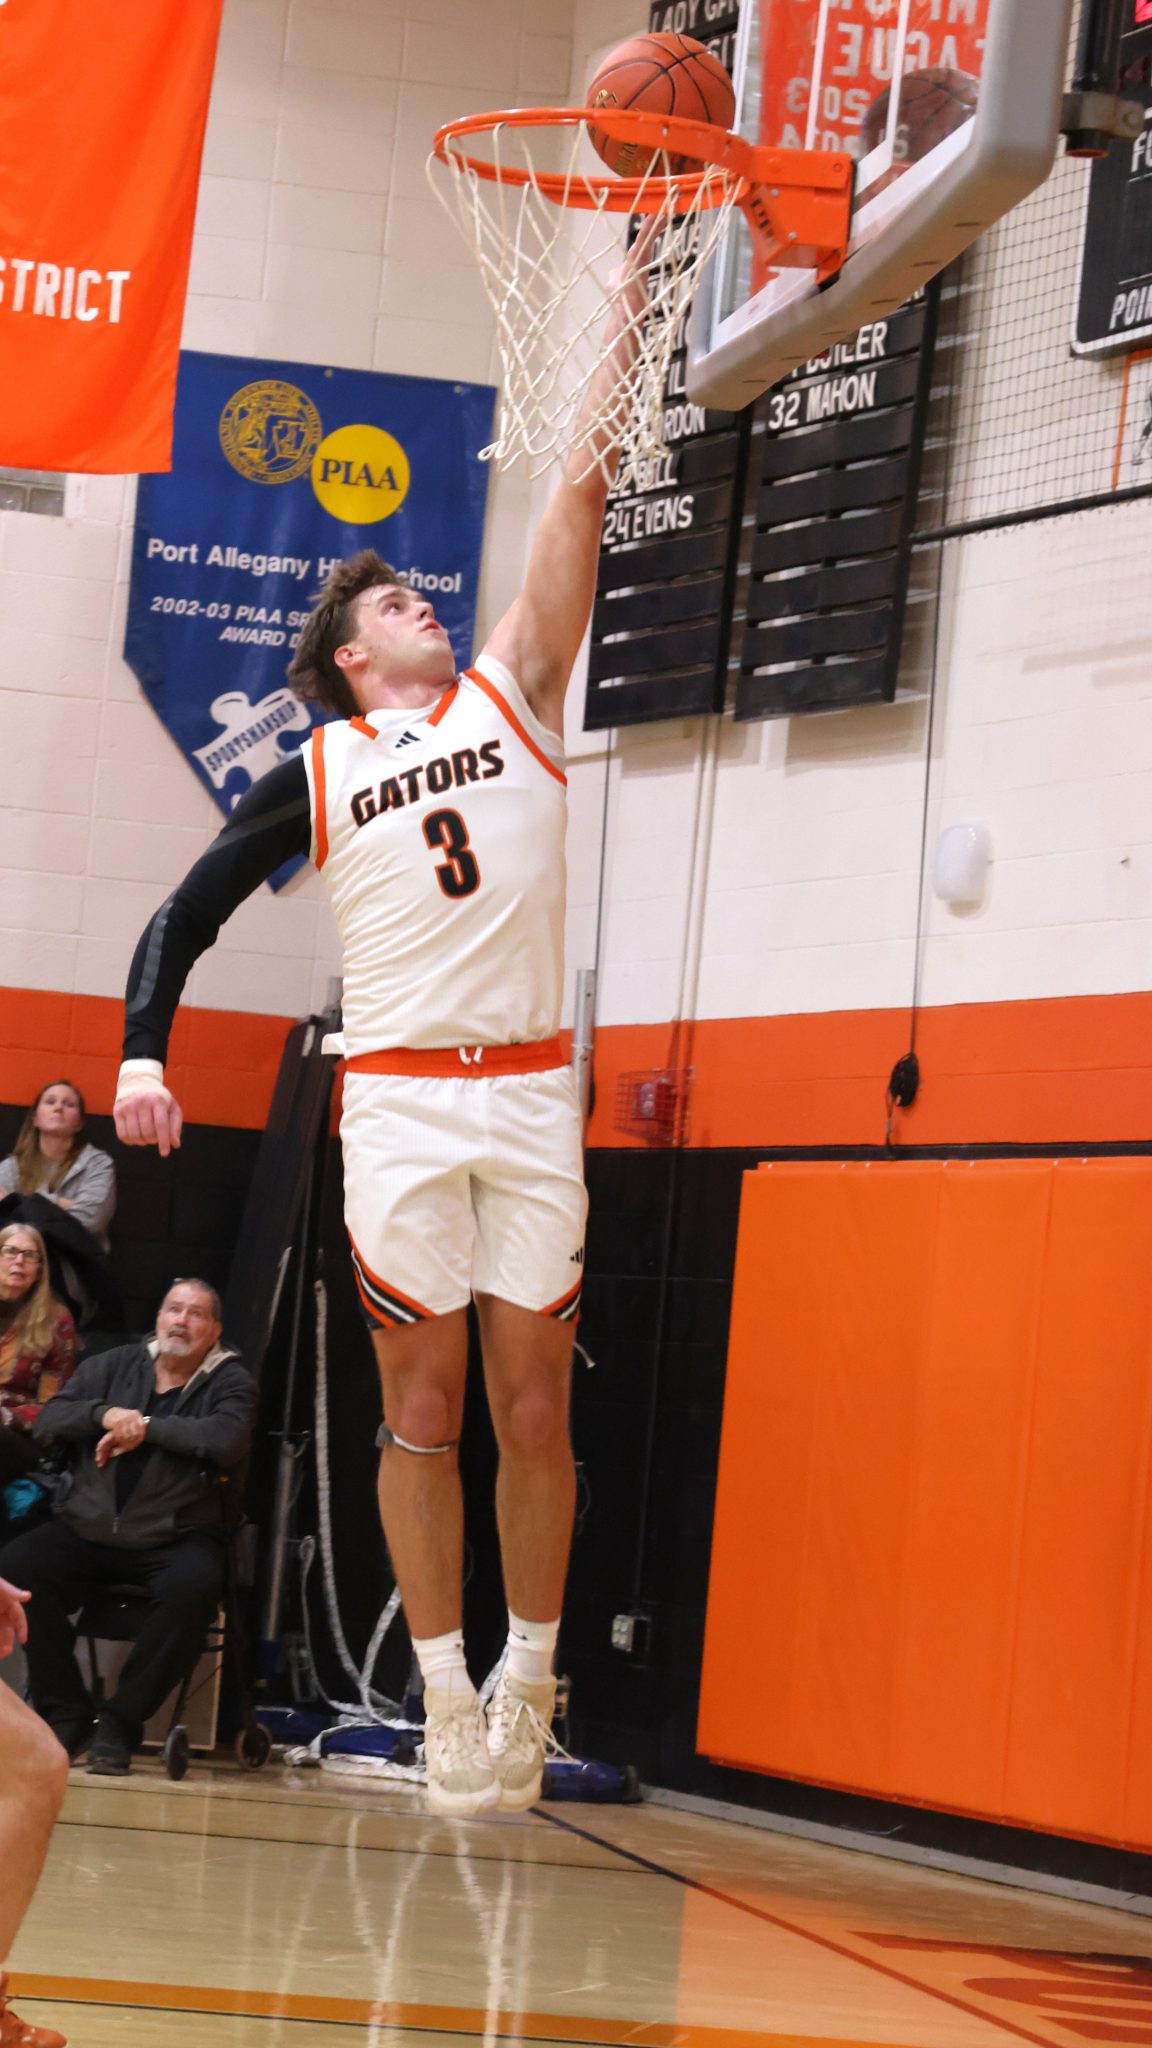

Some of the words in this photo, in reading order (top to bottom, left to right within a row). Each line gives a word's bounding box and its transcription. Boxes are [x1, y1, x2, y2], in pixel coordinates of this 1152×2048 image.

[768, 392, 800, 429] 32
[806, 371, 877, 422] MAHON
[320, 458, 401, 491] PIAA
[602, 509, 630, 544] 24
[633, 495, 694, 539] EVENS
[147, 538, 199, 564] Port
[206, 545, 311, 580] Allegany
[150, 596, 231, 619] 2002-03
[235, 605, 282, 625] PIAA
[220, 626, 286, 646] AWARD
[205, 700, 298, 772] SPORTSMANSHIP
[350, 739, 505, 828] GATORS
[422, 807, 481, 900] 3
